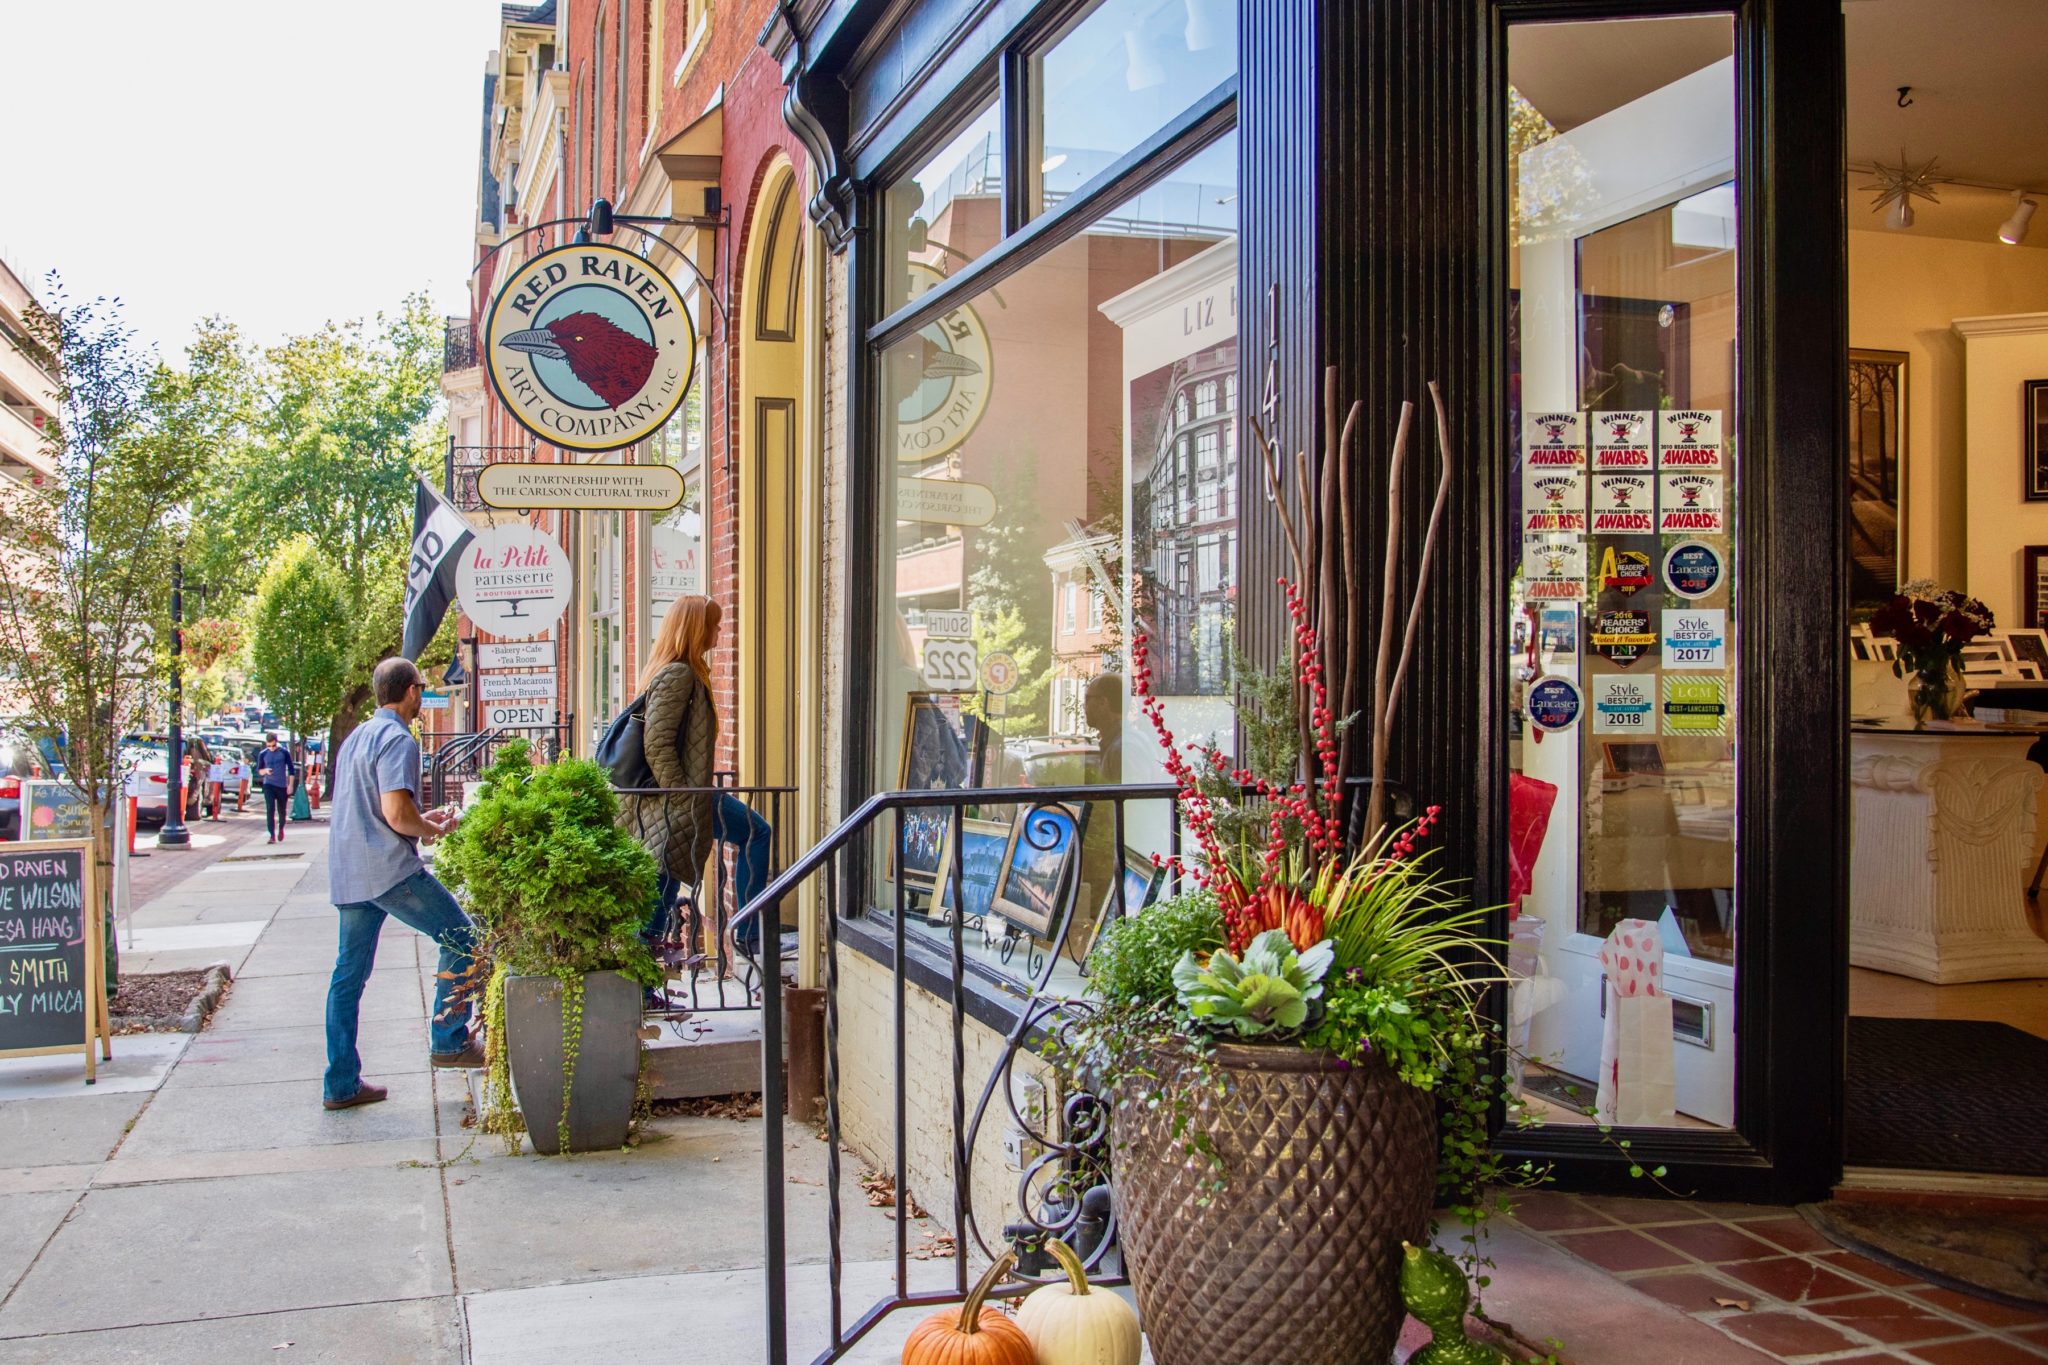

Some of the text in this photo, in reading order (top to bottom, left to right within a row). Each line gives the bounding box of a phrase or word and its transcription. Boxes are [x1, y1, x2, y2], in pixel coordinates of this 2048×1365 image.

[510, 255, 674, 320] RED RAVEN
[1183, 295, 1214, 336] LIZ
[505, 365, 544, 409] ART
[660, 367, 679, 395] LLC
[1535, 414, 1577, 426] WINNER
[1600, 413, 1644, 425] WINNER
[1666, 411, 1712, 424] WINNER
[1528, 449, 1585, 465] AWARDS
[1595, 449, 1648, 465] AWARDS
[1661, 449, 1718, 465] AWARDS
[518, 475, 643, 486] IN PARTNERSHIP WITH
[1534, 476, 1577, 489] WINNER
[1601, 476, 1645, 489] WINNER
[1669, 475, 1714, 488] WINNER
[493, 487, 671, 498] THE CARLSON CULTURAL TRUST
[1526, 514, 1585, 530] AWARDS
[1594, 514, 1652, 529] AWARDS
[1661, 513, 1721, 529] AWARDS
[1533, 544, 1577, 556] WINNER
[1682, 552, 1704, 560] BEST
[1670, 564, 1718, 574] Lancaster
[1526, 582, 1585, 597] AWARDS
[1681, 579, 1707, 589] 2015
[1600, 619, 1647, 627] READERS'
[1678, 617, 1709, 633] Style
[1605, 626, 1640, 634] CHOICE
[1675, 632, 1712, 640] BEST OF
[494, 645, 543, 655] Bakery Cafe
[1611, 645, 1637, 656] LNP
[1677, 649, 1711, 660] 2017
[500, 656, 514, 664] Tea
[483, 678, 553, 687] French Macarons
[486, 687, 548, 699] Sunday Brunch
[1610, 683, 1639, 698] Style
[1678, 687, 1711, 698] LCM
[1531, 698, 1578, 708] Lancaster
[1607, 697, 1642, 705] BEST OF
[493, 708, 544, 724] OPEN
[1608, 713, 1641, 724] 2018
[14, 859, 68, 877] RAVEN
[21, 879, 81, 910] WILSON
[32, 915, 73, 939] HAAG
[10, 958, 68, 988] SMITH
[31, 989, 83, 1014] MICCA
